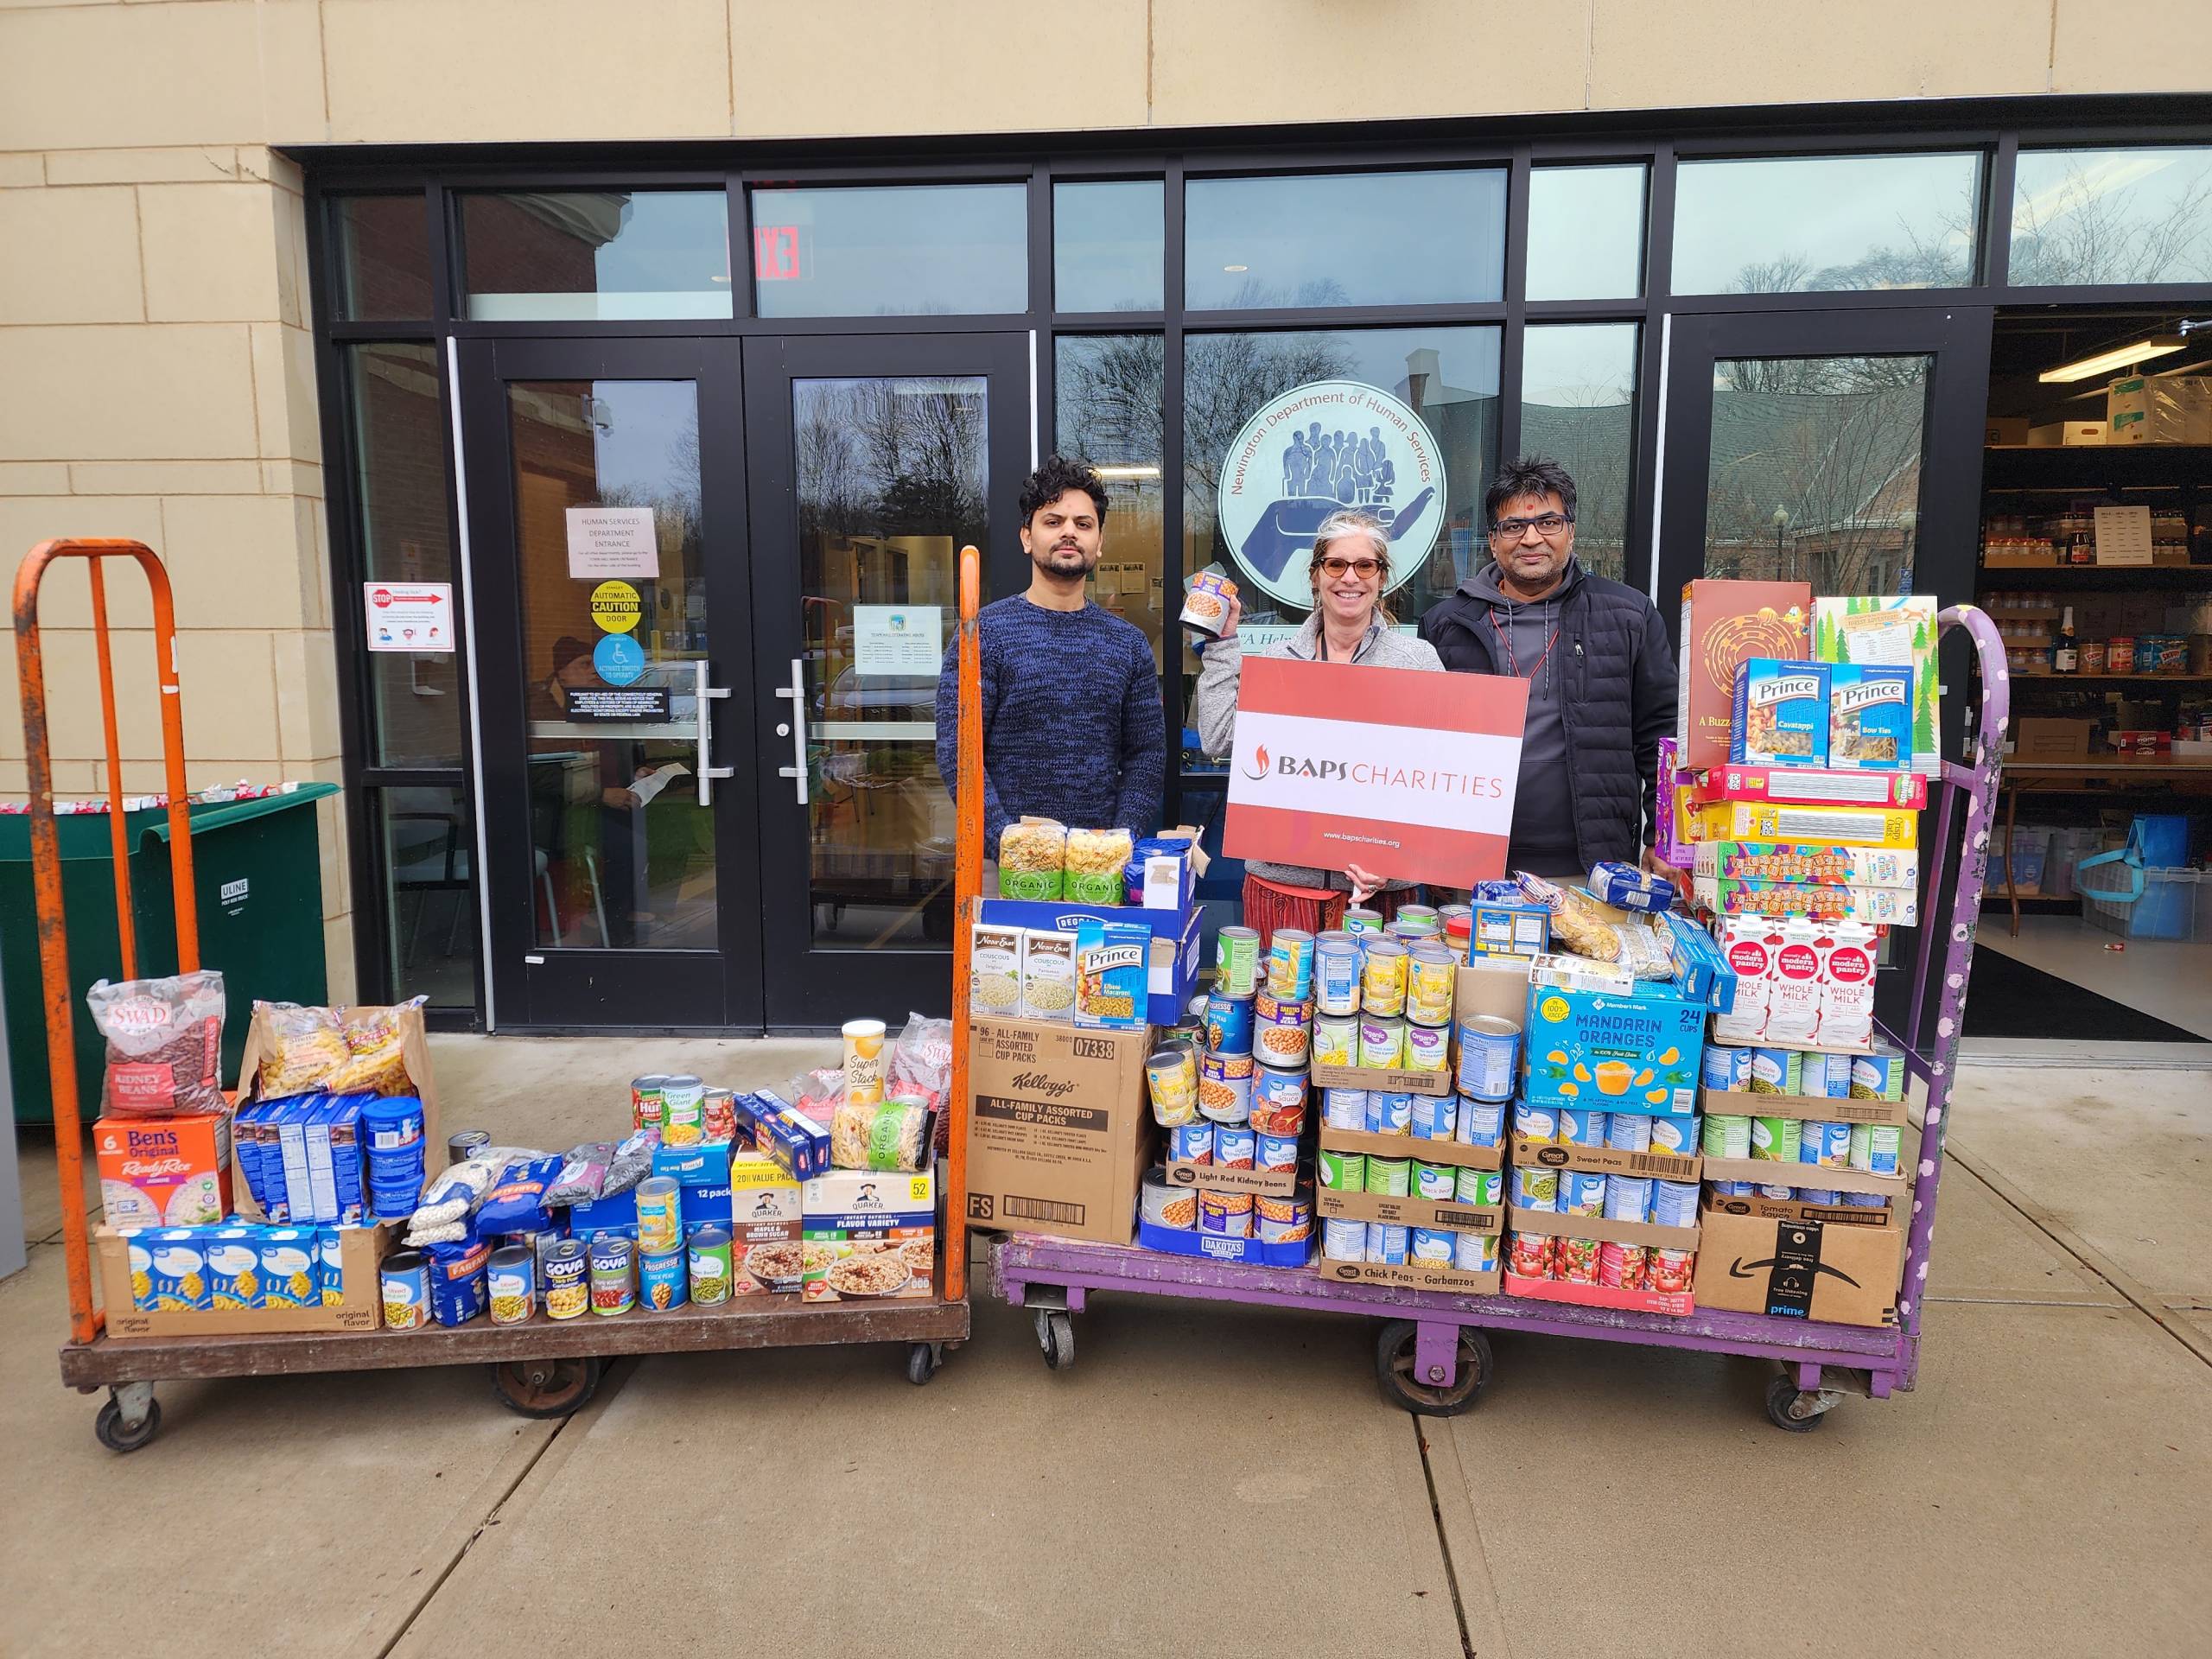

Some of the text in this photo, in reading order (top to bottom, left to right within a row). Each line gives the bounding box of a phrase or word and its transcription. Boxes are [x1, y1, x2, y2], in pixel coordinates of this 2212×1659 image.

[1231, 391, 1431, 495] Newington Department of Human Services
[373, 594, 391, 603] STOP
[592, 602, 639, 612] CAUTION
[1760, 681, 1814, 699] Prince
[1846, 685, 1900, 705] Prince
[1699, 716, 1707, 727] A
[1778, 721, 1814, 731] Cavatappi
[1278, 755, 1503, 799] BAPS CHARITIES
[1886, 819, 1895, 837] Oats
[1892, 817, 1904, 842] Crispy
[1324, 831, 1401, 849] www.bapscharities.org
[1878, 855, 1888, 880] Crunch
[223, 881, 247, 896] ULINE
[1005, 879, 1055, 889] ORGANIC
[1071, 881, 1122, 891] ORGANIC
[1878, 893, 1888, 918] Crunch
[976, 936, 1014, 947] Near East
[1030, 941, 1070, 953] Near East
[1034, 957, 1065, 966] COUSCOUS
[1090, 950, 1137, 967] Prince
[1732, 954, 1764, 963] modern
[1781, 957, 1815, 966] modern
[1831, 960, 1866, 969] modern
[1738, 982, 1763, 990] HOLE
[1780, 983, 1814, 994] WHOLE
[1830, 987, 1866, 996] WHOLE
[1783, 992, 1809, 1001] MILK
[1834, 995, 1861, 1004] MILK
[1605, 1001, 1632, 1010] Member's
[114, 1007, 167, 1026] SWAD
[1679, 1009, 1701, 1025] 24
[1575, 1014, 1663, 1033] MANDARIN
[1679, 1025, 1699, 1033] CUPS
[980, 1027, 1039, 1042] 96 ALL-FAMILY
[1363, 1029, 1385, 1039] Organic
[1411, 1033, 1437, 1043] Organic
[1579, 1029, 1656, 1048] ORANGES
[995, 1039, 1033, 1052] ASSORTED
[1075, 1038, 1114, 1060] 07338
[850, 1055, 880, 1071] Super
[995, 1050, 1037, 1065] CUP PACKS
[1761, 1071, 1776, 1079] Beans
[1762, 1065, 1776, 1074] Style
[1860, 1070, 1875, 1078] Style
[115, 1074, 161, 1084] KIDNEY
[850, 1070, 879, 1084] Stack
[118, 1084, 157, 1095] BEANS
[1012, 1071, 1076, 1097] Kellogg's
[990, 1098, 1093, 1120] ALL-FAMILY ASSORTED
[1015, 1111, 1067, 1126] CUP PACKS
[128, 1128, 177, 1147] Ben's
[879, 1109, 893, 1160] ORGANIC
[104, 1135, 118, 1150] 6
[130, 1146, 180, 1159] Original
[1541, 1150, 1565, 1160] Great
[1576, 1155, 1623, 1166] Sweet Peas
[122, 1159, 193, 1178] Ready Rice
[737, 1174, 747, 1183] 20
[752, 1173, 775, 1182] VALUE
[1199, 1172, 1217, 1183] Light
[1220, 1174, 1236, 1183] Red
[1236, 1176, 1263, 1187] Kidney
[697, 1188, 732, 1199] 12 pack
[912, 1183, 926, 1196] 52
[1421, 1185, 1438, 1194] Black
[852, 1202, 884, 1211] QUAKER
[969, 1196, 992, 1217] FS
[1759, 1205, 1794, 1214] Tomato
[752, 1210, 784, 1218] QUAKER
[1761, 1211, 1790, 1219] Sauce
[1781, 1223, 1805, 1231] streaming
[1205, 1238, 1243, 1252] DAKOTA'S
[545, 1259, 584, 1275] GOYA
[593, 1256, 628, 1271] GOYA
[645, 1257, 678, 1272] PROGRESSO
[1364, 1268, 1475, 1287] Chick Peas Garbanzos
[336, 1309, 370, 1321] original
[1770, 1305, 1805, 1317] prime
[116, 1317, 149, 1328] original
[343, 1318, 371, 1328] flavor
